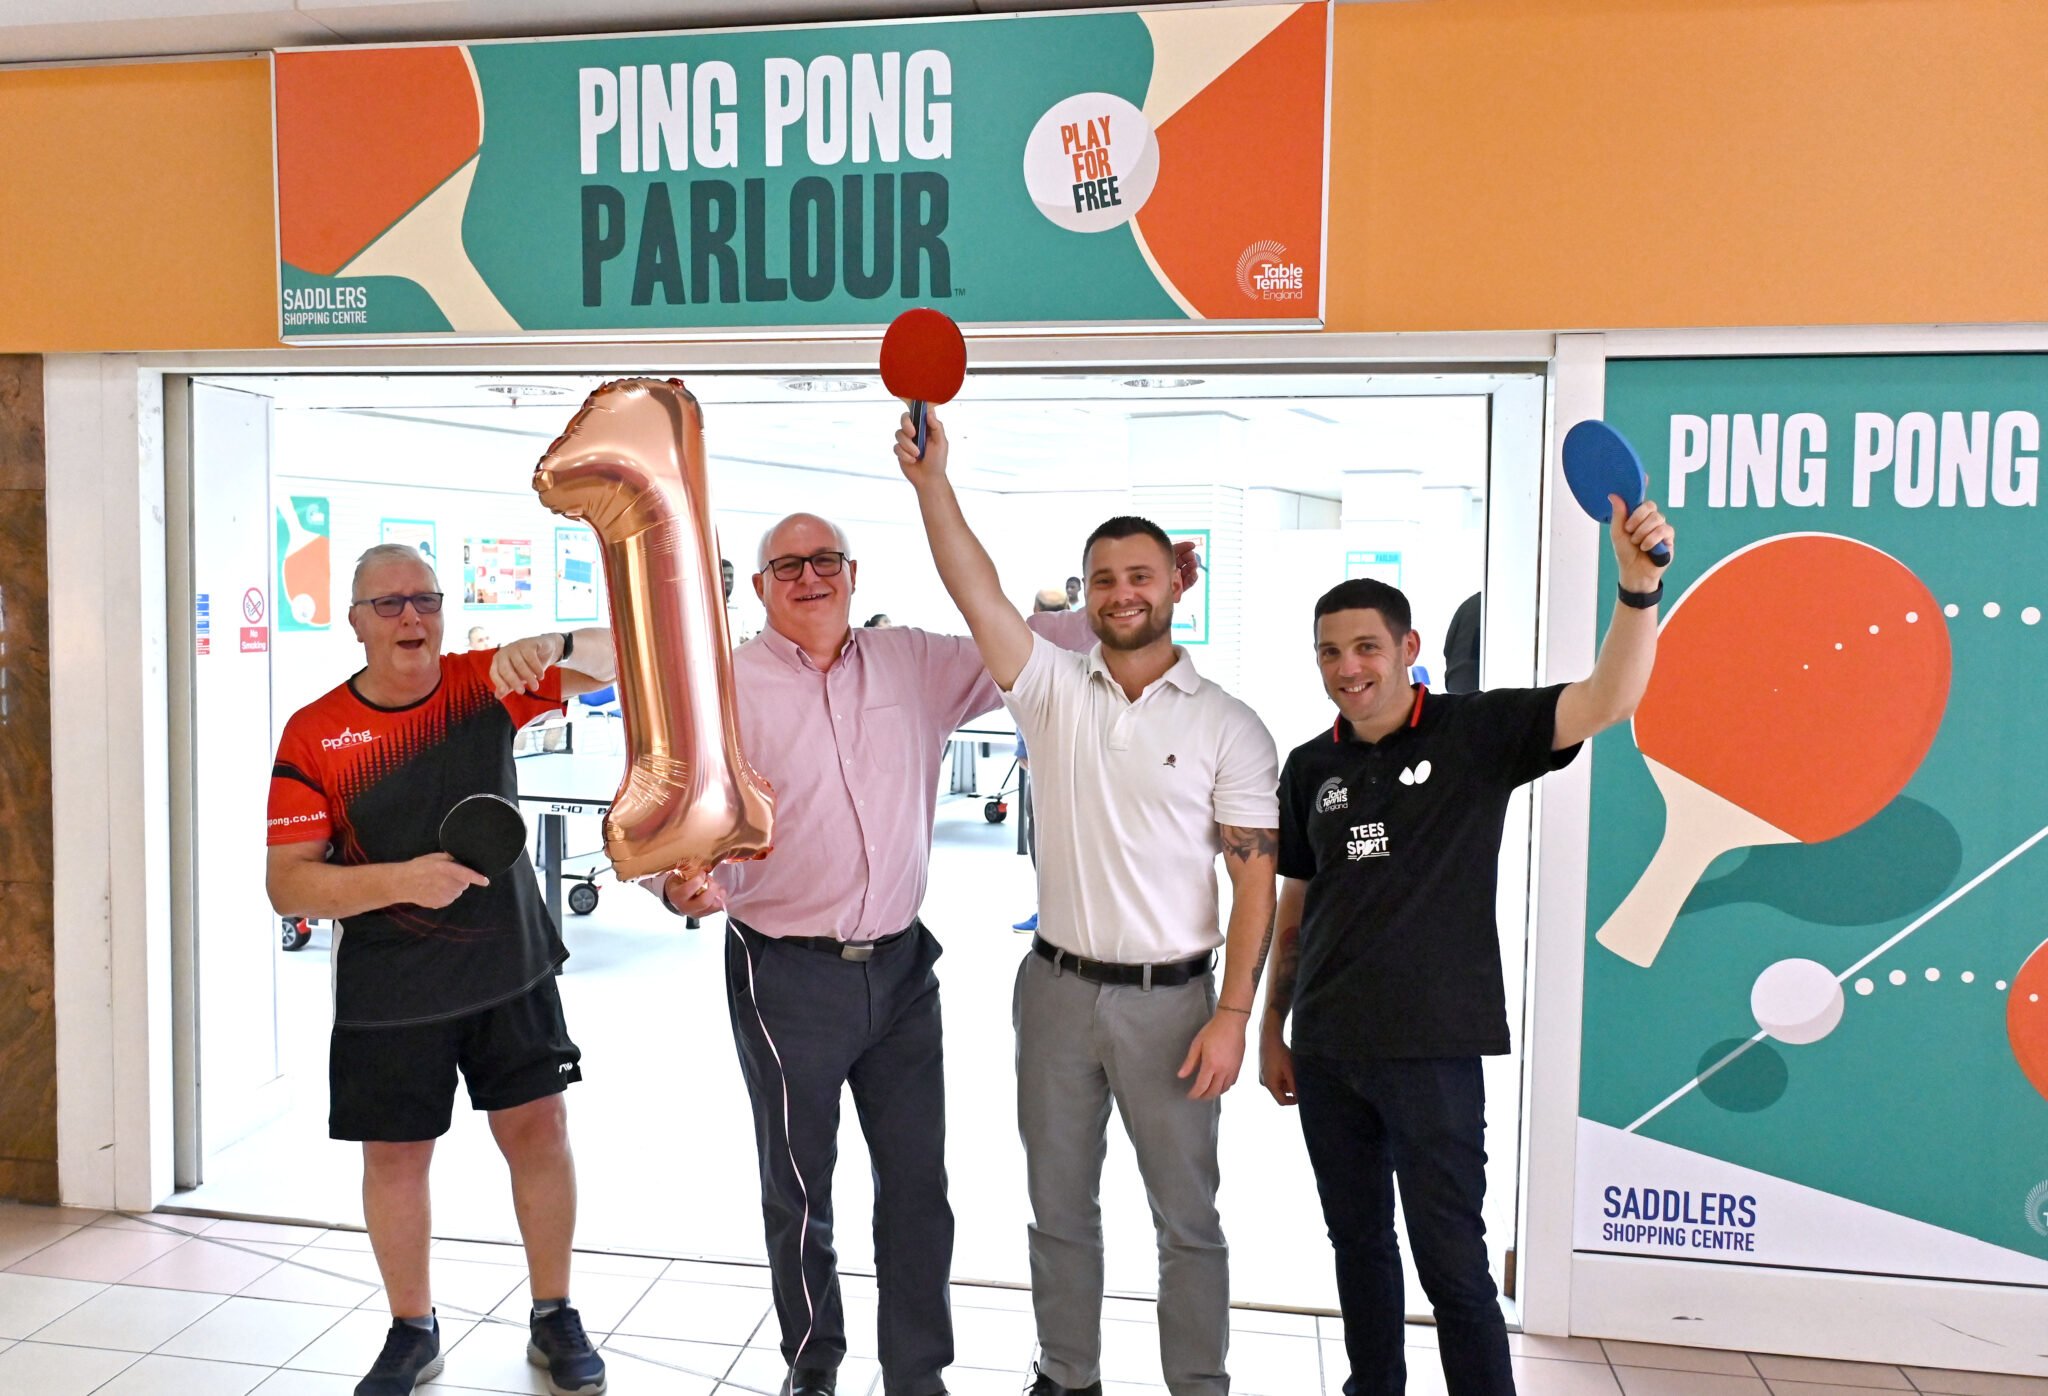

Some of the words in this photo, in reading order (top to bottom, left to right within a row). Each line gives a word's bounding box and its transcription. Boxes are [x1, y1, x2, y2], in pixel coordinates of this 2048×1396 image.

[579, 61, 738, 175] PING
[764, 49, 952, 167] PONG
[1060, 115, 1111, 155] PLAY
[1072, 147, 1112, 183] FOR
[1072, 175, 1122, 213] FREE
[580, 171, 952, 307] PARLOUR
[1253, 275, 1303, 290] Tennis
[1261, 263, 1303, 279] Table
[283, 287, 367, 310] SADDLERS
[1263, 290, 1303, 302] England
[283, 312, 330, 326] SHOPPING
[332, 311, 368, 324] CENTRE
[1668, 412, 1828, 508] PING
[1852, 410, 2040, 508] PONG
[551, 804, 583, 814] 540
[1350, 822, 1385, 839] TEES
[1603, 1185, 1757, 1228] SADDLERS
[1602, 1222, 1686, 1247] SHOPPING
[1692, 1228, 1755, 1252] CENTRE
